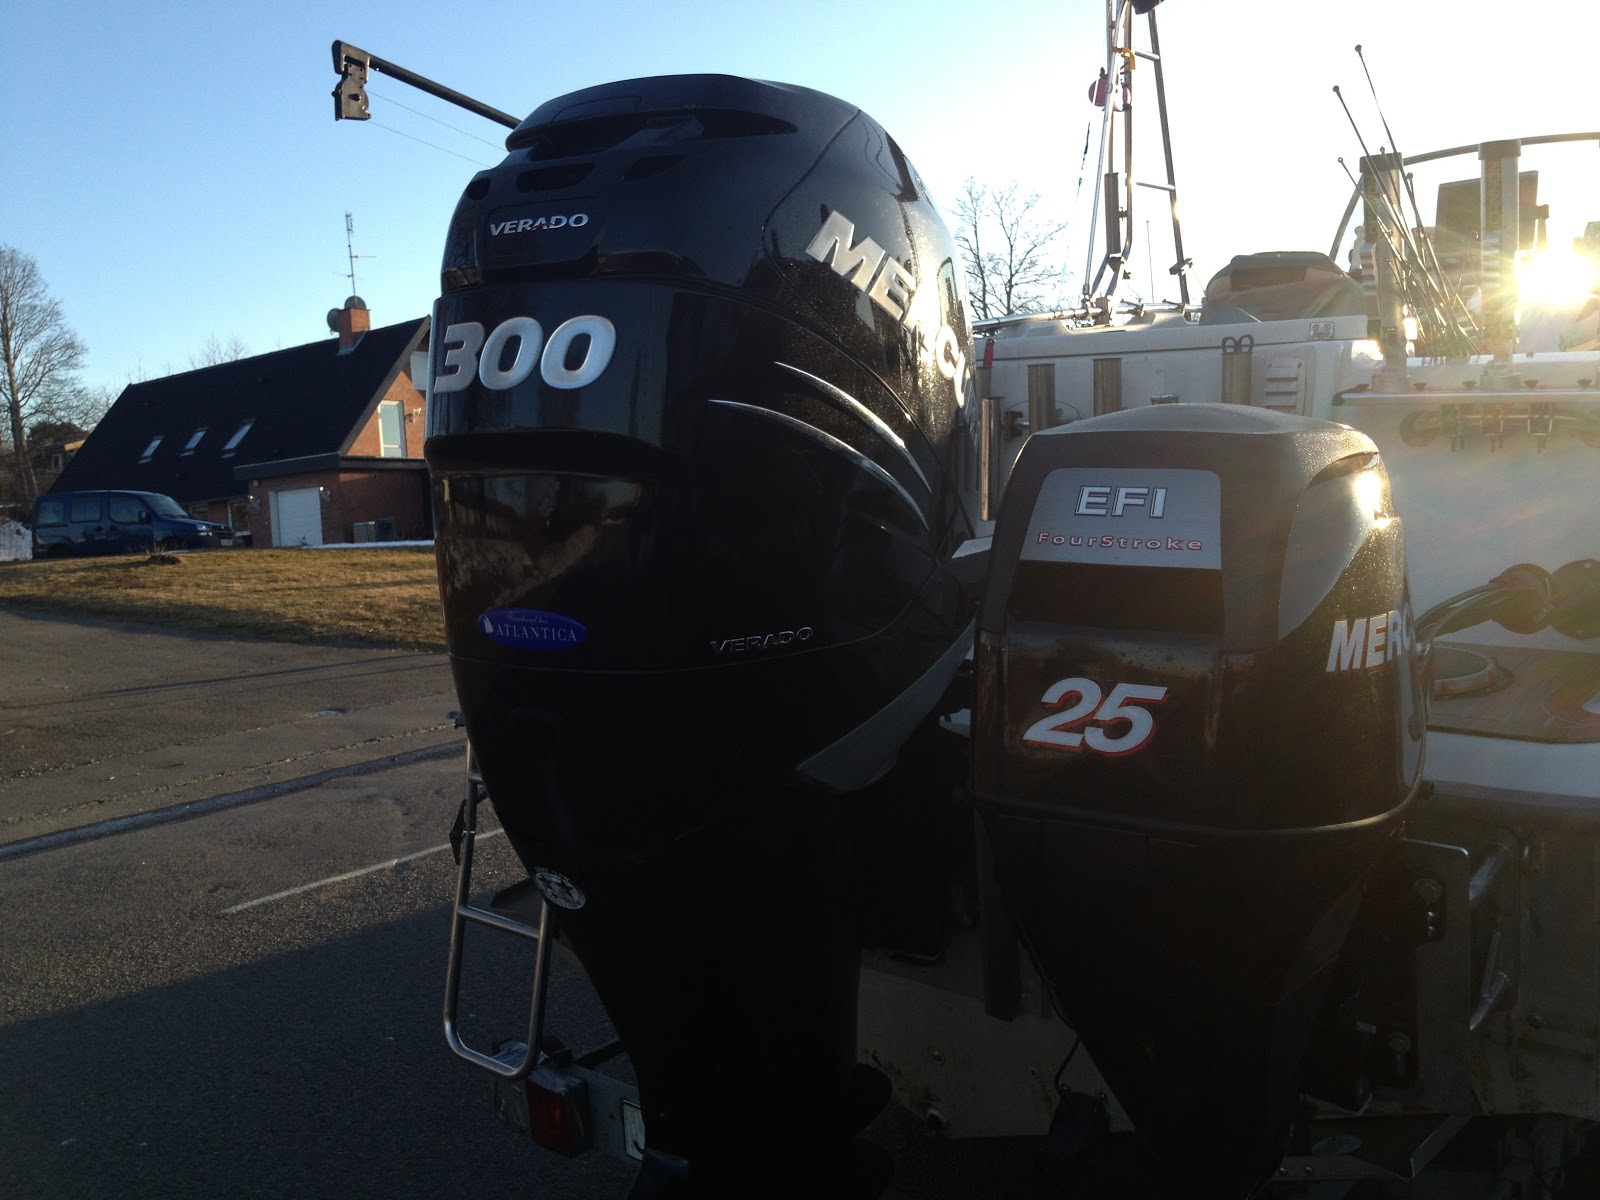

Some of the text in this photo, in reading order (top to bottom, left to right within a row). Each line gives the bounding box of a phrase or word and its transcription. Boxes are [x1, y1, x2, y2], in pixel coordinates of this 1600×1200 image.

[490, 213, 589, 236] VERADO
[434, 314, 616, 393] 300
[1074, 486, 1168, 518] EFI
[1036, 532, 1203, 551] FourStroke
[496, 624, 577, 641] ATLANTICA
[709, 626, 813, 655] VERADO
[1023, 677, 1169, 757] 25
